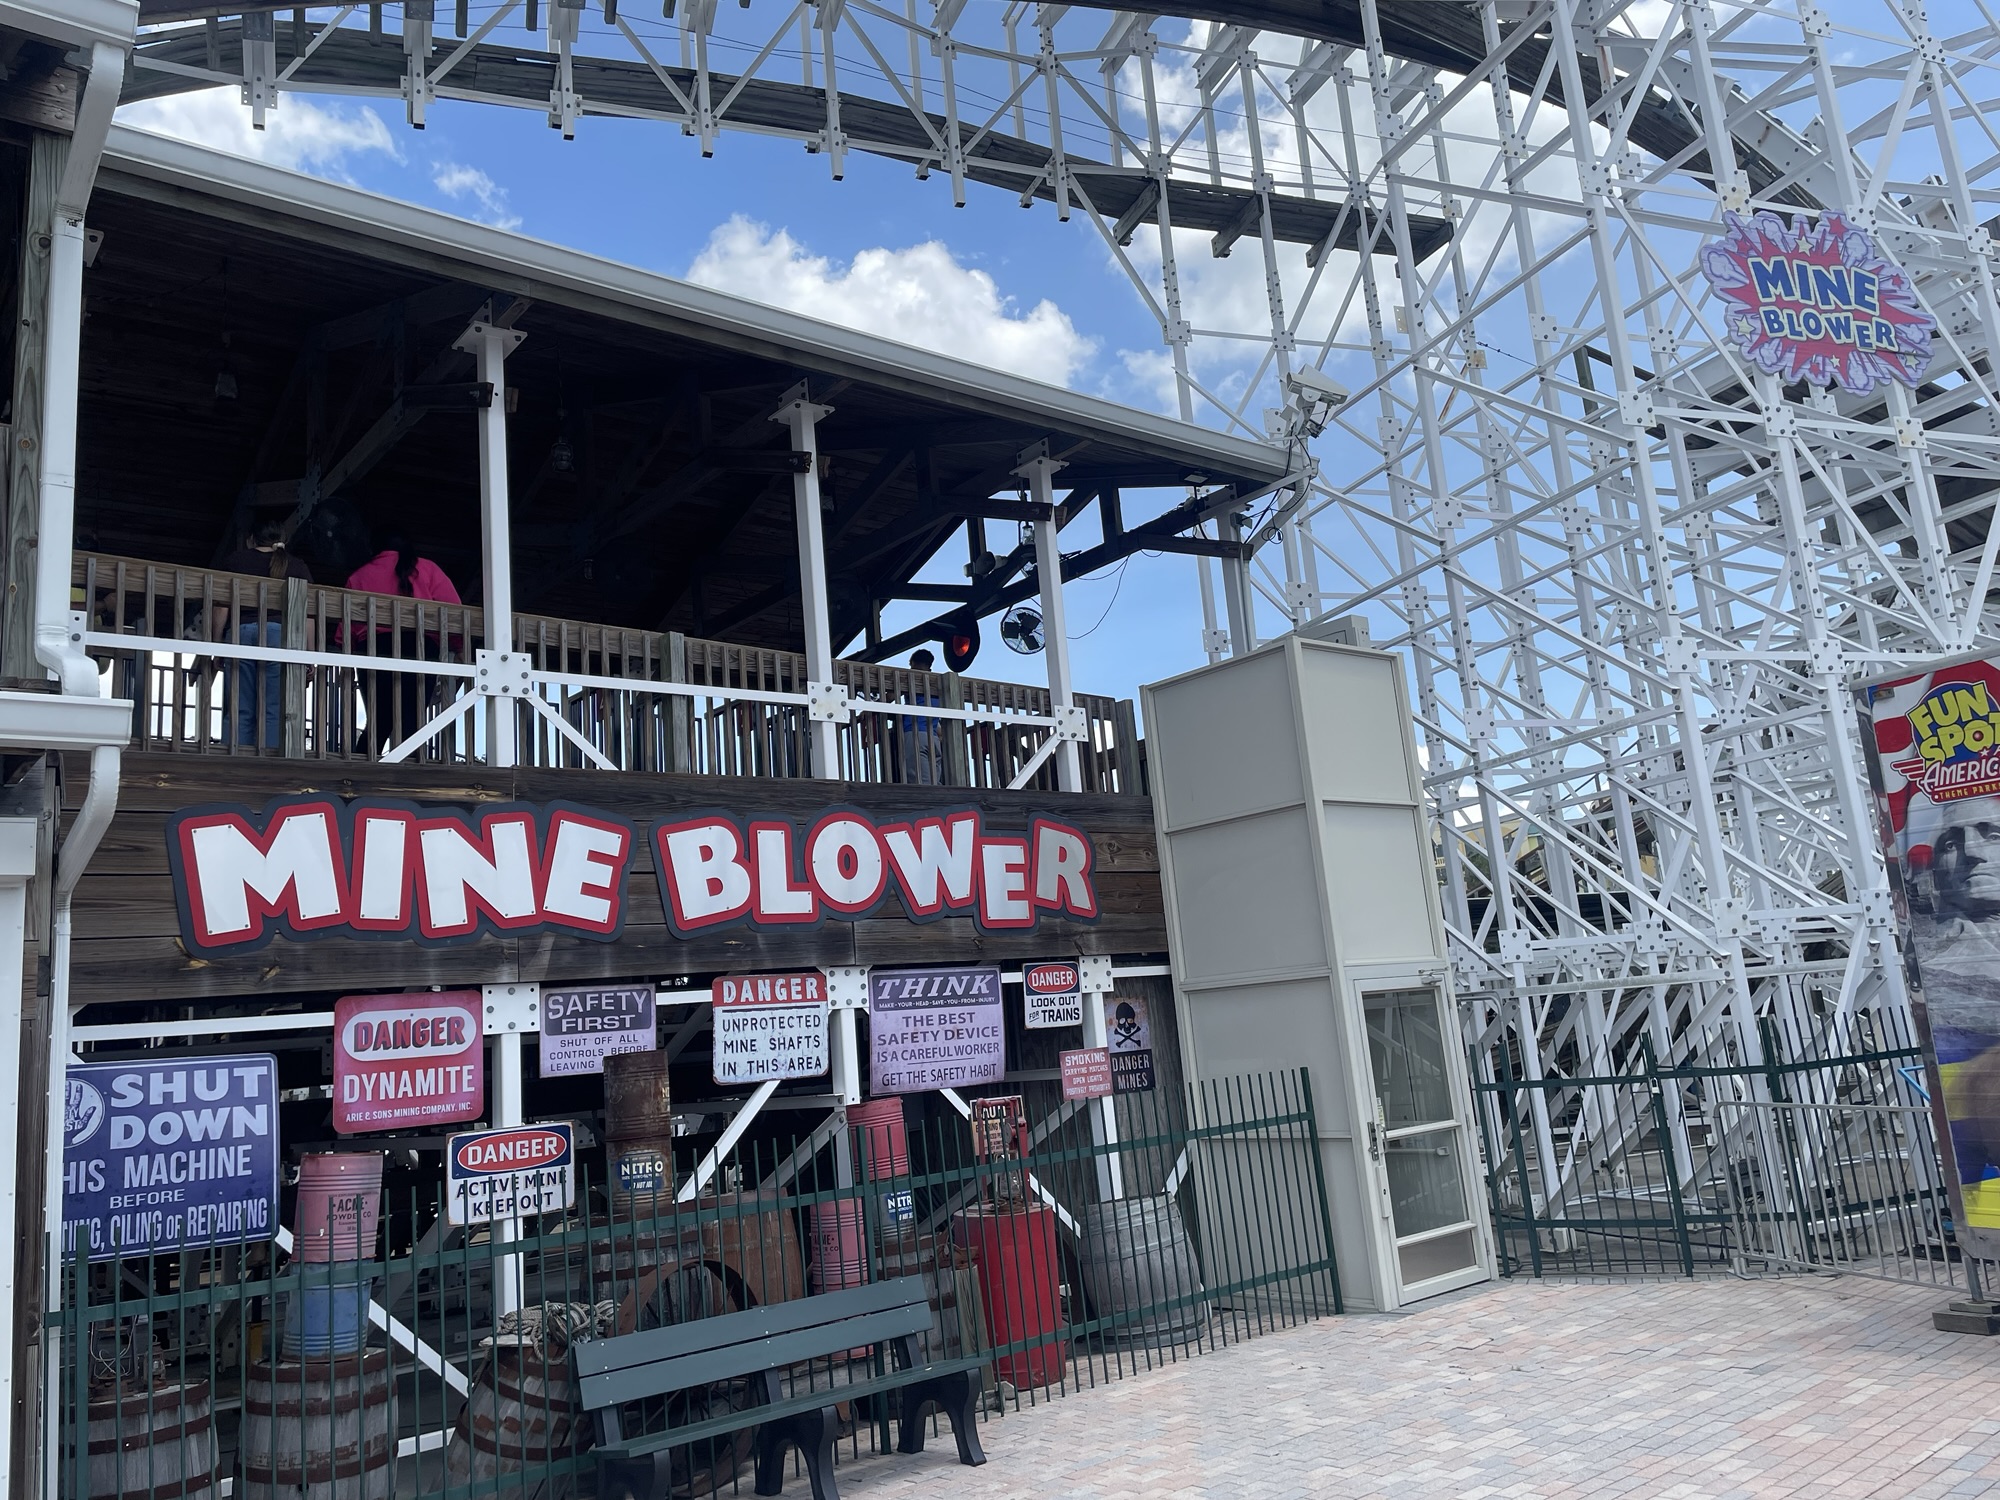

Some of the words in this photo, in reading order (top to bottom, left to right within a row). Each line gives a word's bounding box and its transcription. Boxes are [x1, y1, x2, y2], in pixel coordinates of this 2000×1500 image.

[1748, 256, 1879, 315] MINE
[1758, 306, 1899, 353] BLOWER
[1908, 683, 1990, 741] FUN
[1921, 755, 2000, 793] AMERIC
[1939, 787, 1969, 800] THEME
[180, 806, 625, 945] MINE
[660, 810, 1098, 928] BLOWER
[878, 974, 994, 999] THINK
[1031, 971, 1074, 987] DANGER
[722, 977, 818, 1003] DANGER
[548, 991, 648, 1020] SAFETY
[1031, 997, 1056, 1008] LOOK
[1059, 996, 1077, 1006] OUT
[562, 1014, 636, 1033] FIRST
[722, 1014, 821, 1033] UNPROTECTED
[902, 1014, 934, 1028] THE
[938, 1012, 976, 1026] BEST
[1029, 1010, 1040, 1021] FOR
[1041, 1008, 1080, 1023] TRAINS
[354, 1015, 466, 1053] DANGER
[560, 1037, 588, 1048] SHUT
[594, 1036, 613, 1046] OFF
[619, 1033, 639, 1044] ALL
[723, 1038, 757, 1054] MINE
[769, 1034, 821, 1051] SHAFTS
[877, 1030, 940, 1046] SAFETY
[944, 1026, 999, 1041] DEVICE
[549, 1048, 604, 1061] CONTROLS
[877, 1052, 888, 1063] IS
[890, 1050, 899, 1062] A
[901, 1046, 953, 1061] CAREFUL
[954, 1042, 1000, 1056] WORKER
[1065, 1052, 1106, 1066] SMOKING
[550, 1060, 595, 1072] LEAVING
[722, 1061, 737, 1076] IN
[747, 1058, 779, 1075] THIS
[788, 1056, 822, 1071] AREA
[1064, 1064, 1088, 1076] CARRYING
[1088, 1064, 1108, 1073] MATCHES
[1112, 1054, 1150, 1072] DANGER
[343, 1064, 475, 1104] DYNAMITE
[882, 1072, 903, 1086] GET
[906, 1070, 927, 1084] THE
[930, 1066, 967, 1082] SAFETY
[970, 1063, 997, 1078] HABIT
[1073, 1077, 1085, 1085] OPEN
[1088, 1075, 1102, 1083] LIGHTS
[1118, 1072, 1148, 1090] MINES
[111, 1066, 268, 1108] SHUT
[346, 1112, 363, 1122] ARIE
[365, 1112, 371, 1120] &
[373, 1109, 393, 1119] SONS
[394, 1106, 420, 1118] MINING
[459, 1102, 473, 1111] INC.
[110, 1104, 268, 1150] DOWN
[468, 1137, 557, 1166] DANGER
[63, 1159, 106, 1195] HIS
[124, 1144, 252, 1189] MACHINE
[621, 1160, 664, 1176] NITRO
[456, 1177, 520, 1198] ACTIVE
[110, 1188, 185, 1209] BEFORE
[473, 1197, 514, 1217] KEEP
[520, 1192, 553, 1209] OUT
[887, 1195, 913, 1209] NITR
[187, 1197, 268, 1237] REPAIRNG
